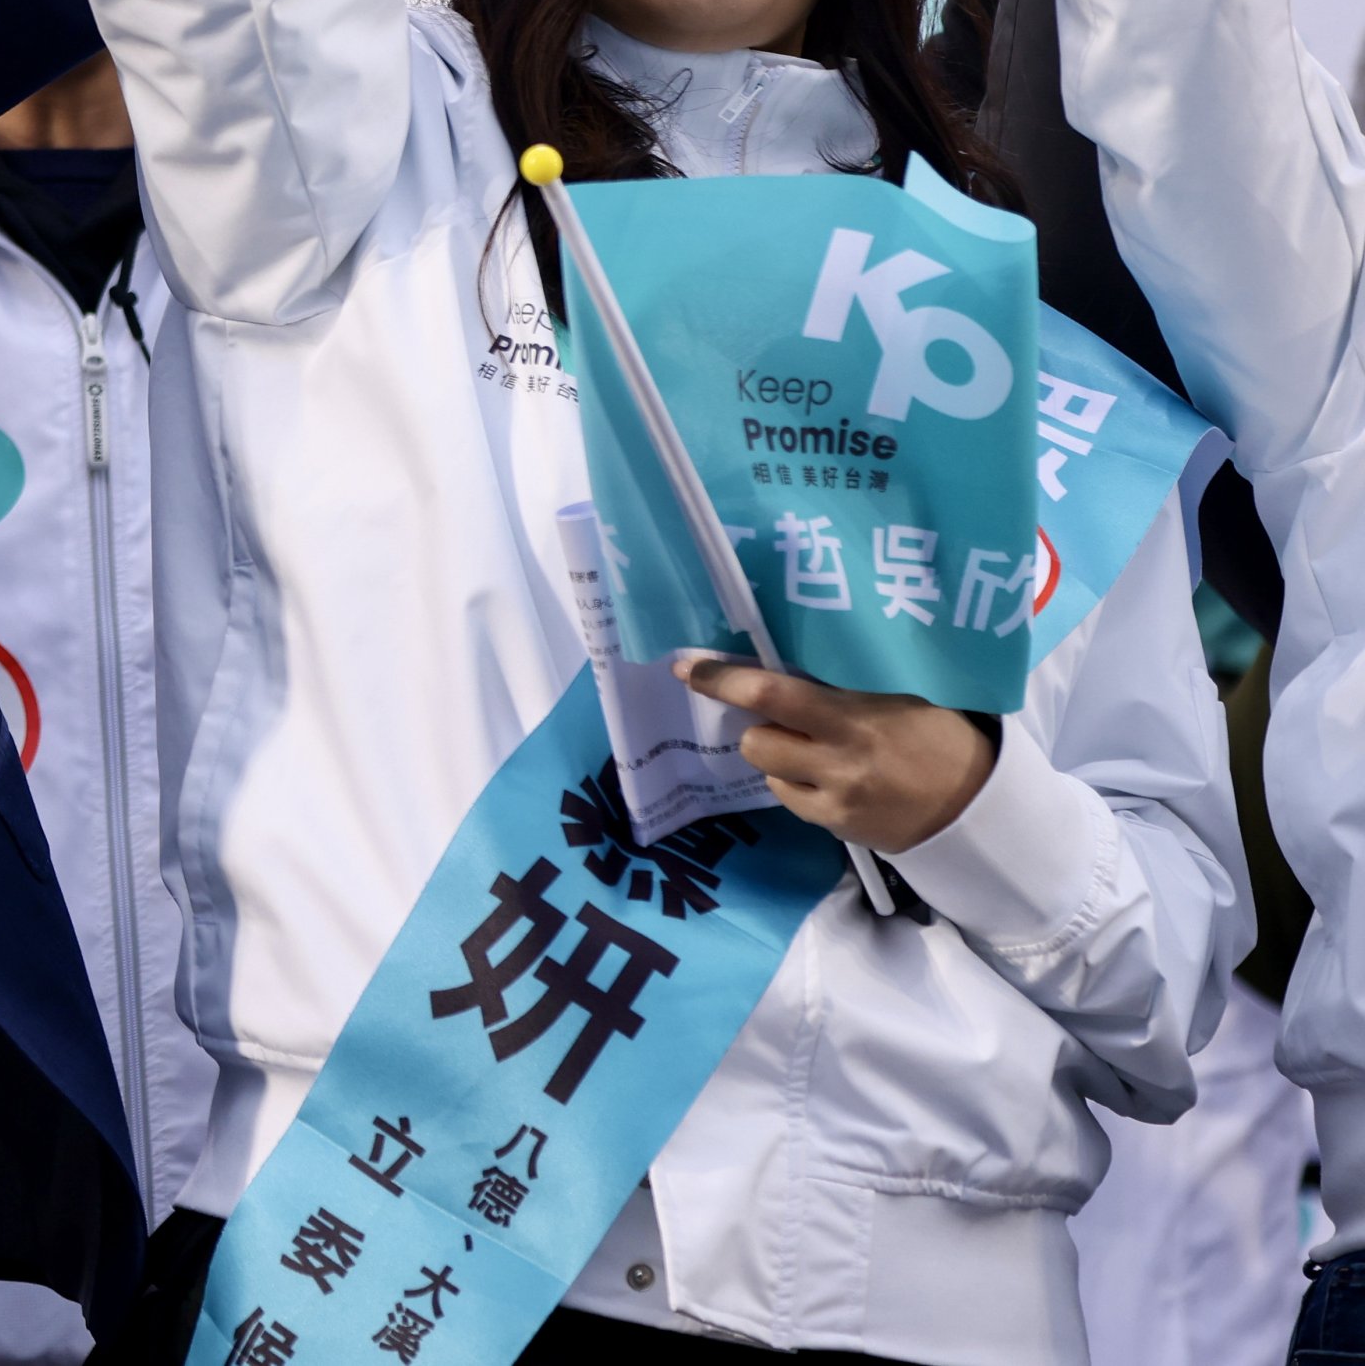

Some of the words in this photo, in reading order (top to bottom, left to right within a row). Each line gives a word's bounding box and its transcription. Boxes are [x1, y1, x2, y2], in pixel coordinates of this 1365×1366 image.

[488, 334, 562, 370] Prom
[735, 368, 834, 417] Keep
[742, 417, 899, 461] Promise
[751, 461, 793, 487] 相信
[801, 464, 891, 494] 美好台灣
